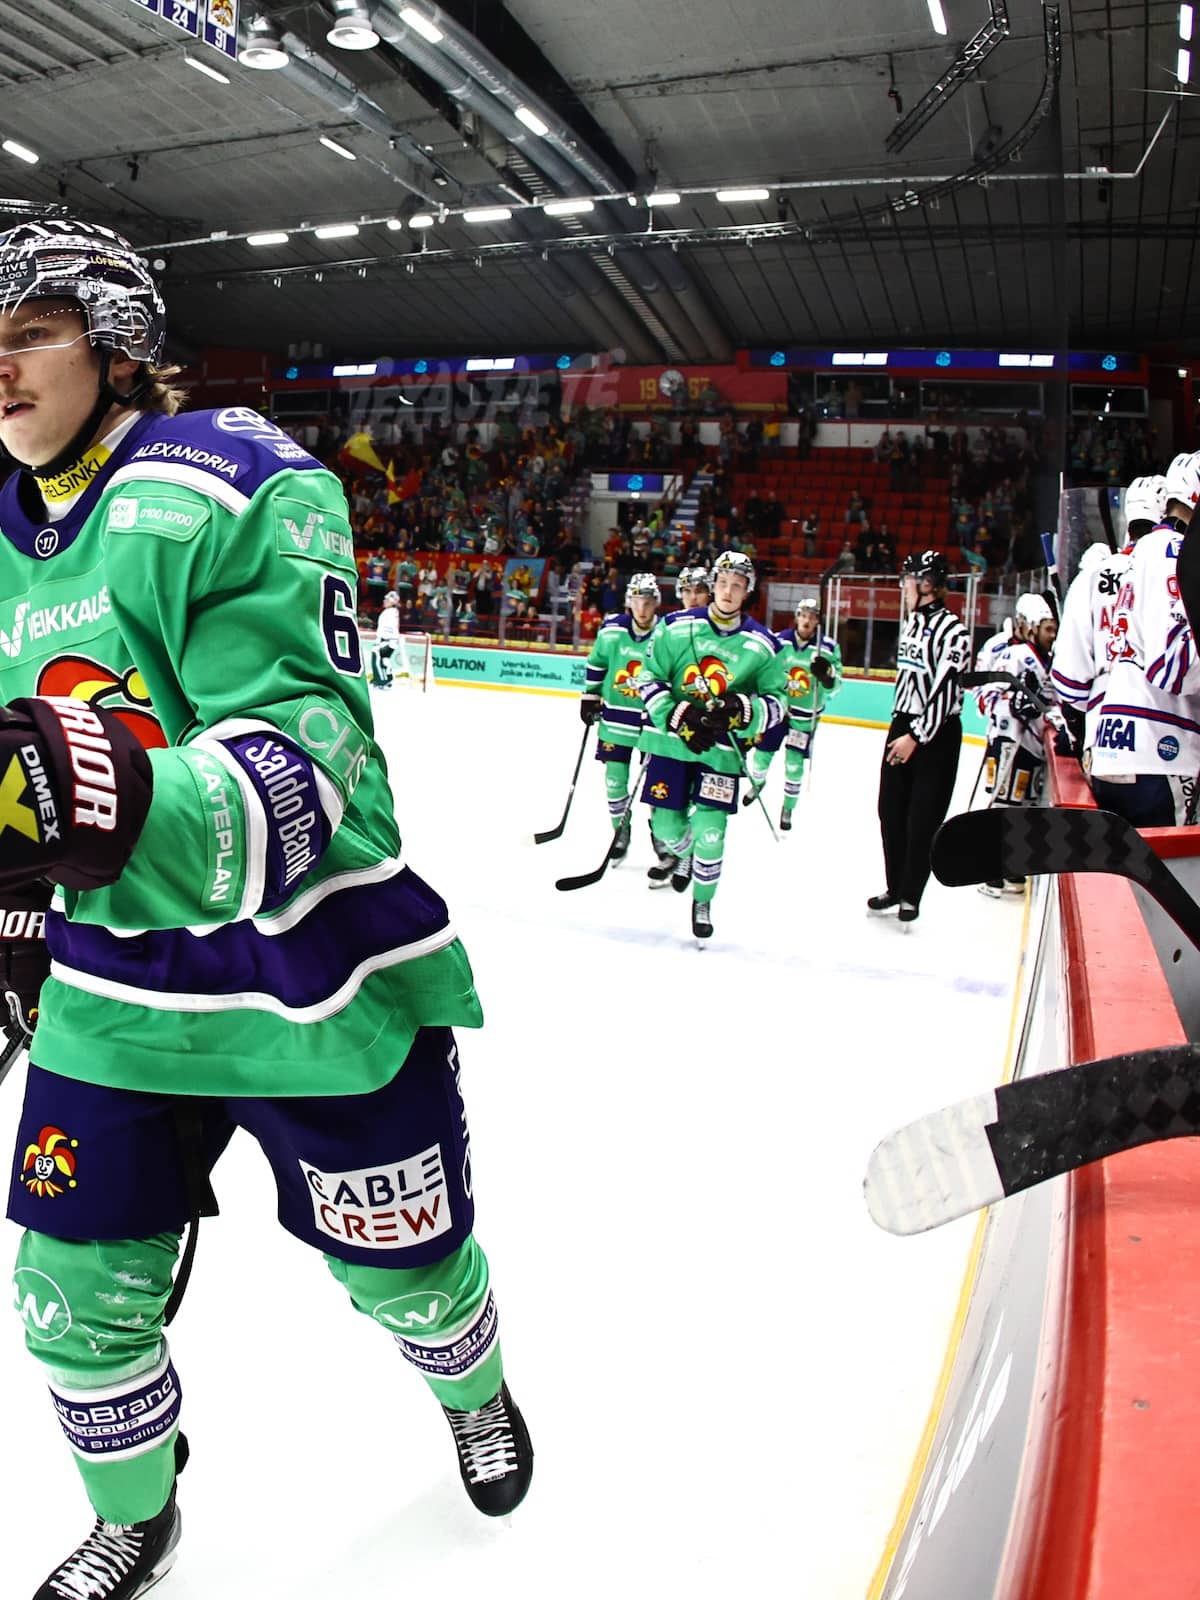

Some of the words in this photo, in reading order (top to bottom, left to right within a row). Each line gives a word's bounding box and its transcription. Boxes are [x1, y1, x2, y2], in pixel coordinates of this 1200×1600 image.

[172, 4, 189, 28] 24
[215, 28, 227, 50] 91
[132, 442, 240, 479] ALEXANDRIA
[139, 507, 163, 520] 0100
[163, 508, 193, 527] 0700
[320, 571, 365, 678] 6
[898, 642, 924, 662] SVEA
[20, 743, 61, 844] DIMEX
[244, 740, 309, 820] Saldo
[278, 810, 317, 887] Bank
[191, 753, 234, 903] KATEPLAN
[306, 1152, 443, 1209] CABLE
[319, 1193, 441, 1243] CREW
[53, 1372, 174, 1425] uroBrand
[73, 1418, 141, 1436] GROUP
